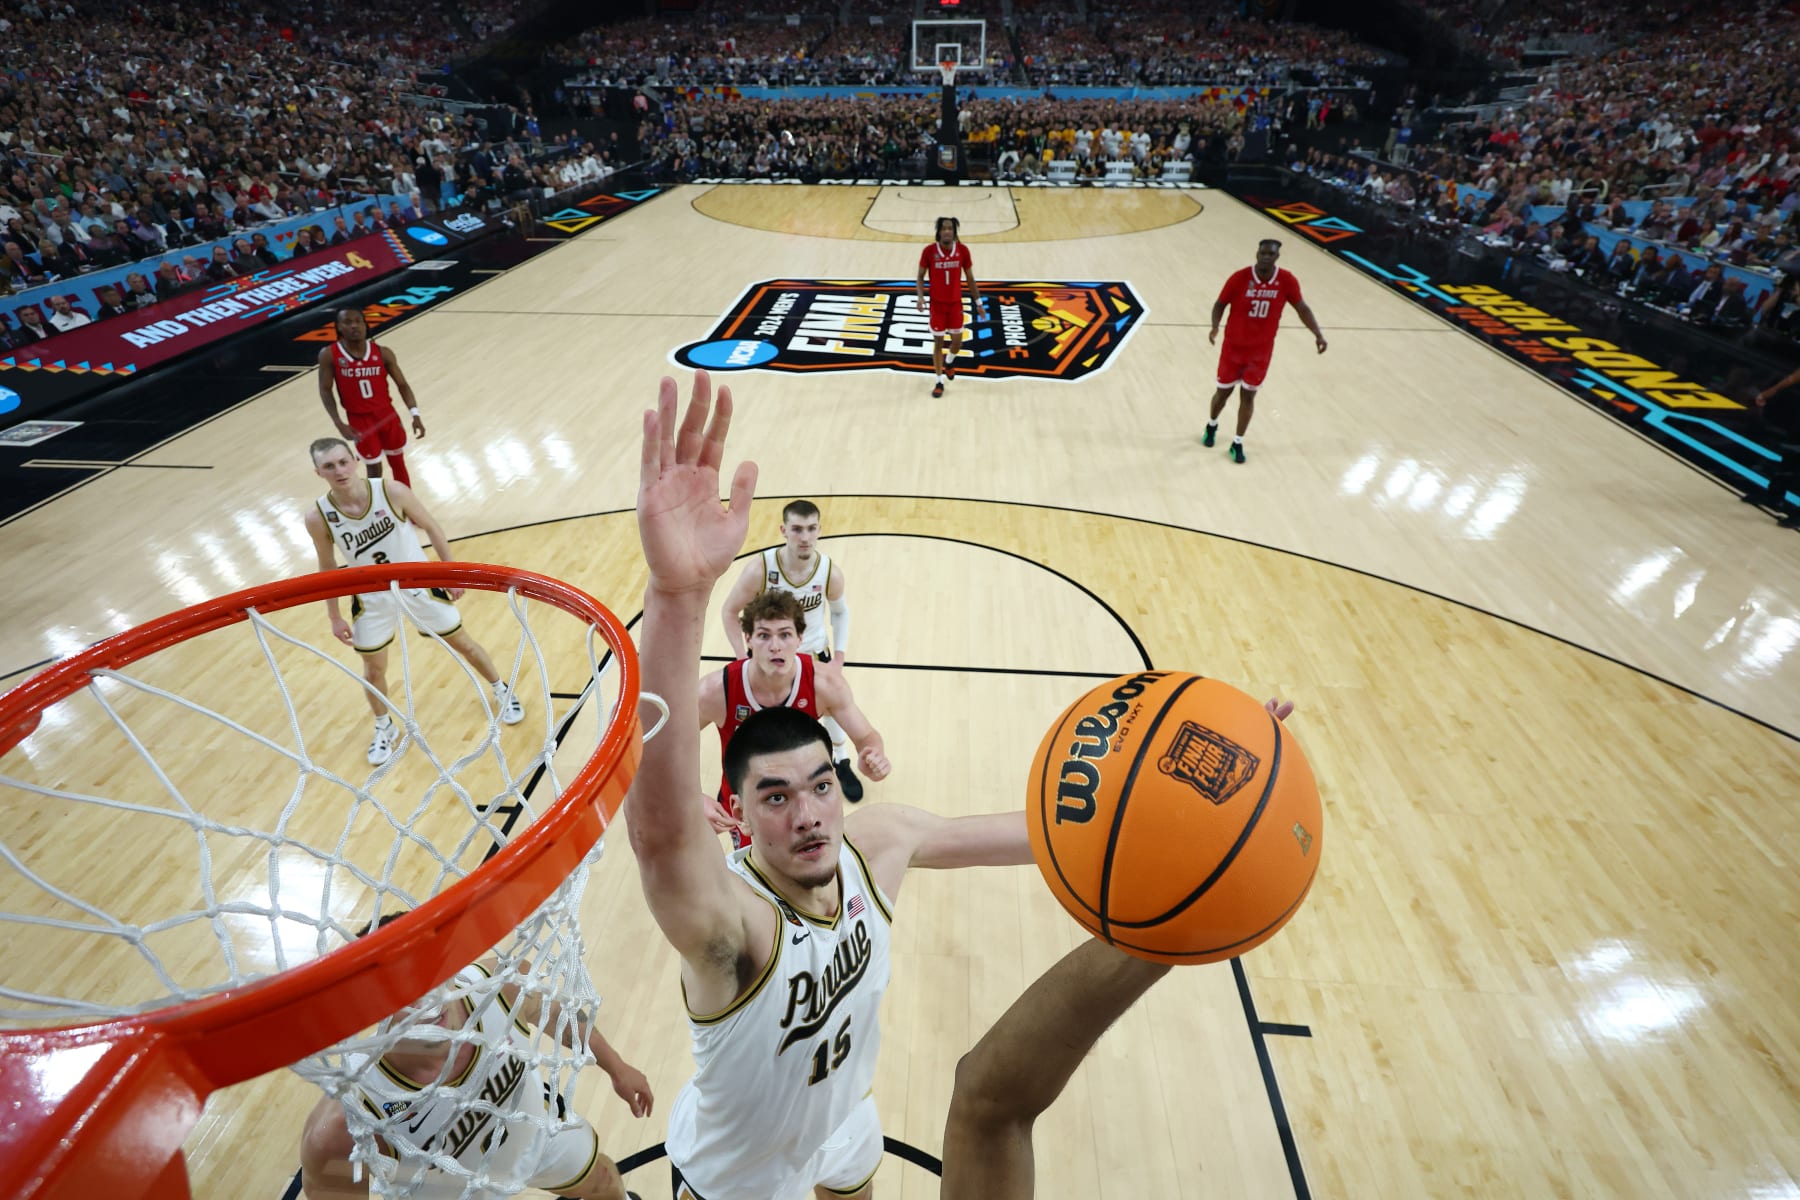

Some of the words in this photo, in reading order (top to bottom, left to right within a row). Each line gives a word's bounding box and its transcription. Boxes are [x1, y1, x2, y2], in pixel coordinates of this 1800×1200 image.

[819, 178, 945, 186] MEN'S
[945, 270, 950, 285] 1
[120, 320, 189, 349] AND
[175, 298, 250, 327] THEN
[235, 274, 309, 305] THERE
[297, 259, 355, 289] WERE
[346, 251, 374, 270] 4
[768, 292, 800, 316] MEN'S
[1248, 300, 1270, 318] 30
[1439, 284, 1582, 332] HERE
[753, 313, 786, 336] 2024
[787, 293, 890, 357] FINAL
[1000, 304, 1030, 347] PHOENIX
[341, 367, 354, 378] NC
[355, 366, 381, 377] STATE
[725, 340, 763, 366] NCAA
[1541, 336, 1747, 410] ENDS
[359, 379, 373, 399] 0
[341, 516, 395, 552] Purdue
[372, 551, 390, 565] 2
[1056, 671, 1177, 826] Wilson
[1112, 727, 1130, 753] EVO
[1126, 702, 1144, 725] NXT
[1177, 735, 1210, 777] FINAL
[1193, 743, 1226, 788] FOUR
[780, 919, 872, 1029] Purdue
[808, 1014, 851, 1087] 15
